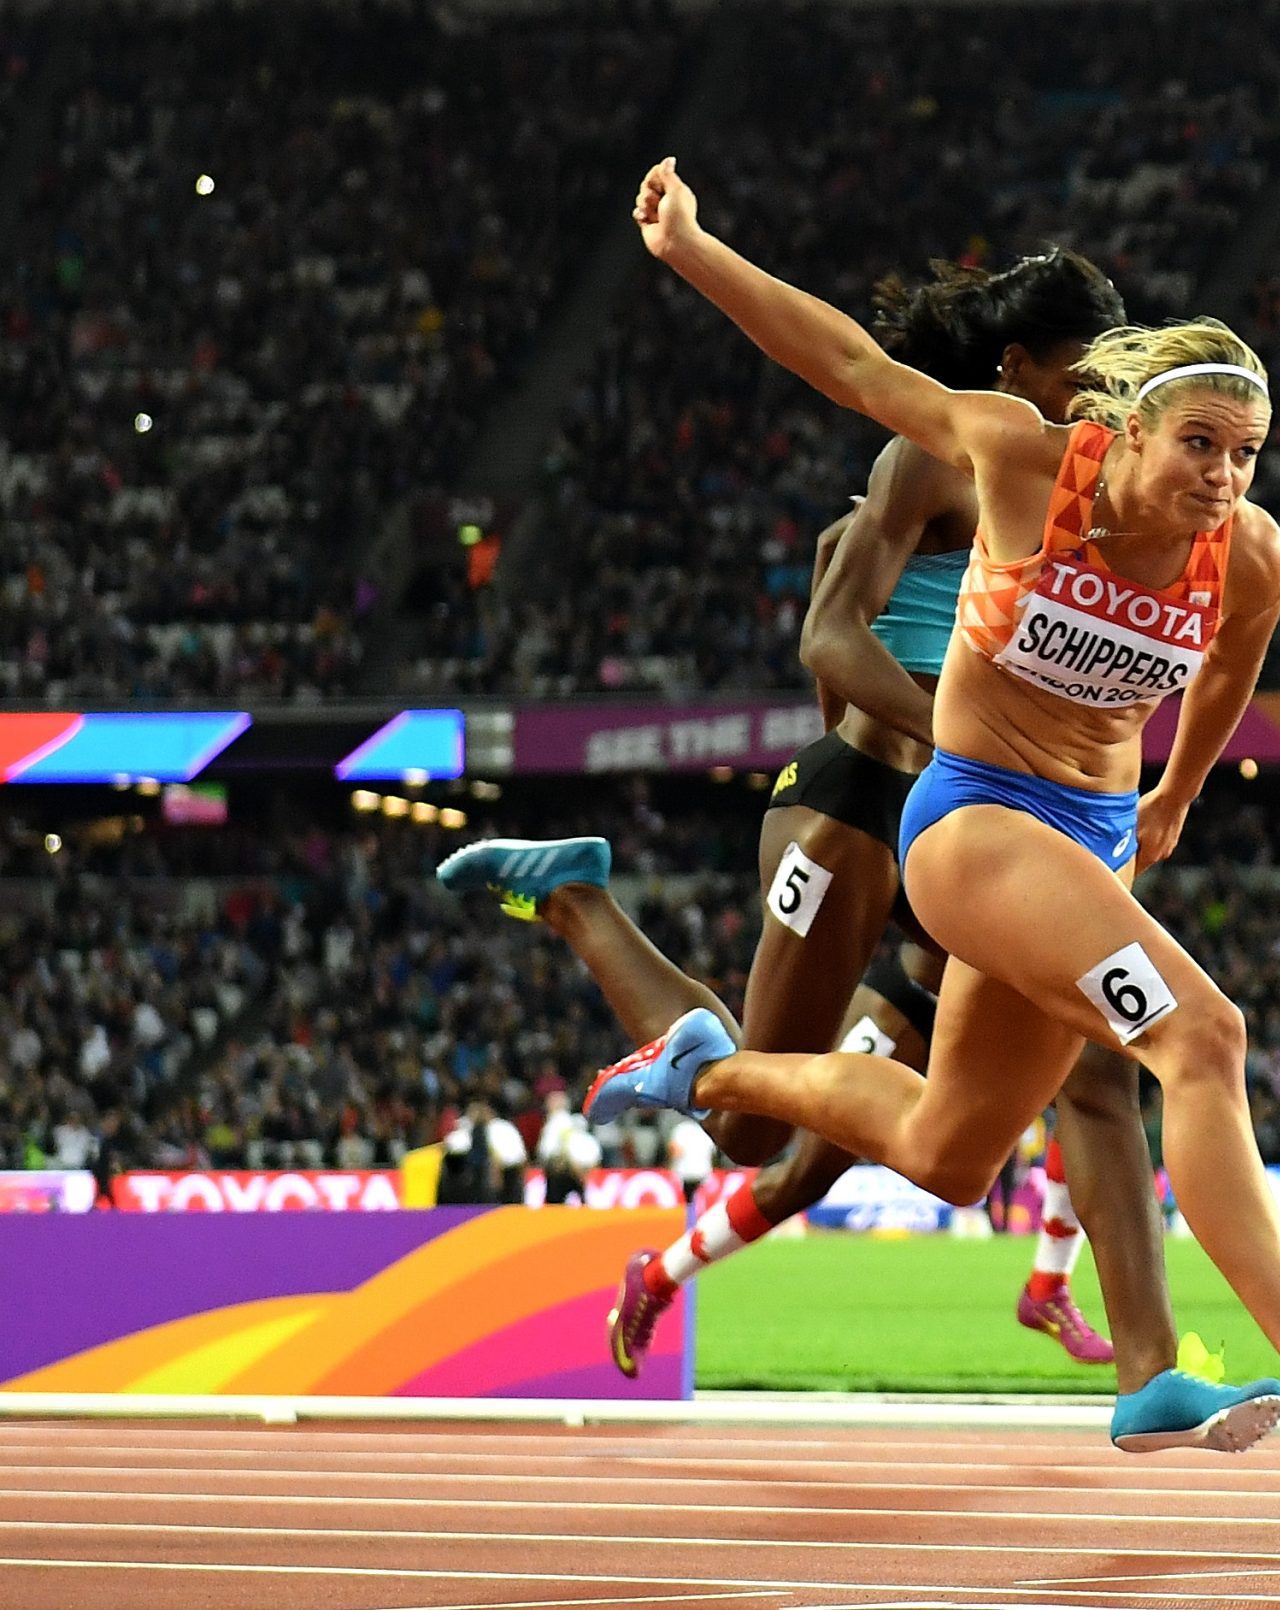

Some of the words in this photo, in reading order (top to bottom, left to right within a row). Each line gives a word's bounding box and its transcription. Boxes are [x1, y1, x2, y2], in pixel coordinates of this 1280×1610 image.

[1051, 561, 1202, 645] TOYOTA
[1018, 612, 1188, 691] SCHIPPERS
[778, 865, 812, 915] 5
[1101, 966, 1148, 1022] 6
[127, 1172, 400, 1212] TOYOTA
